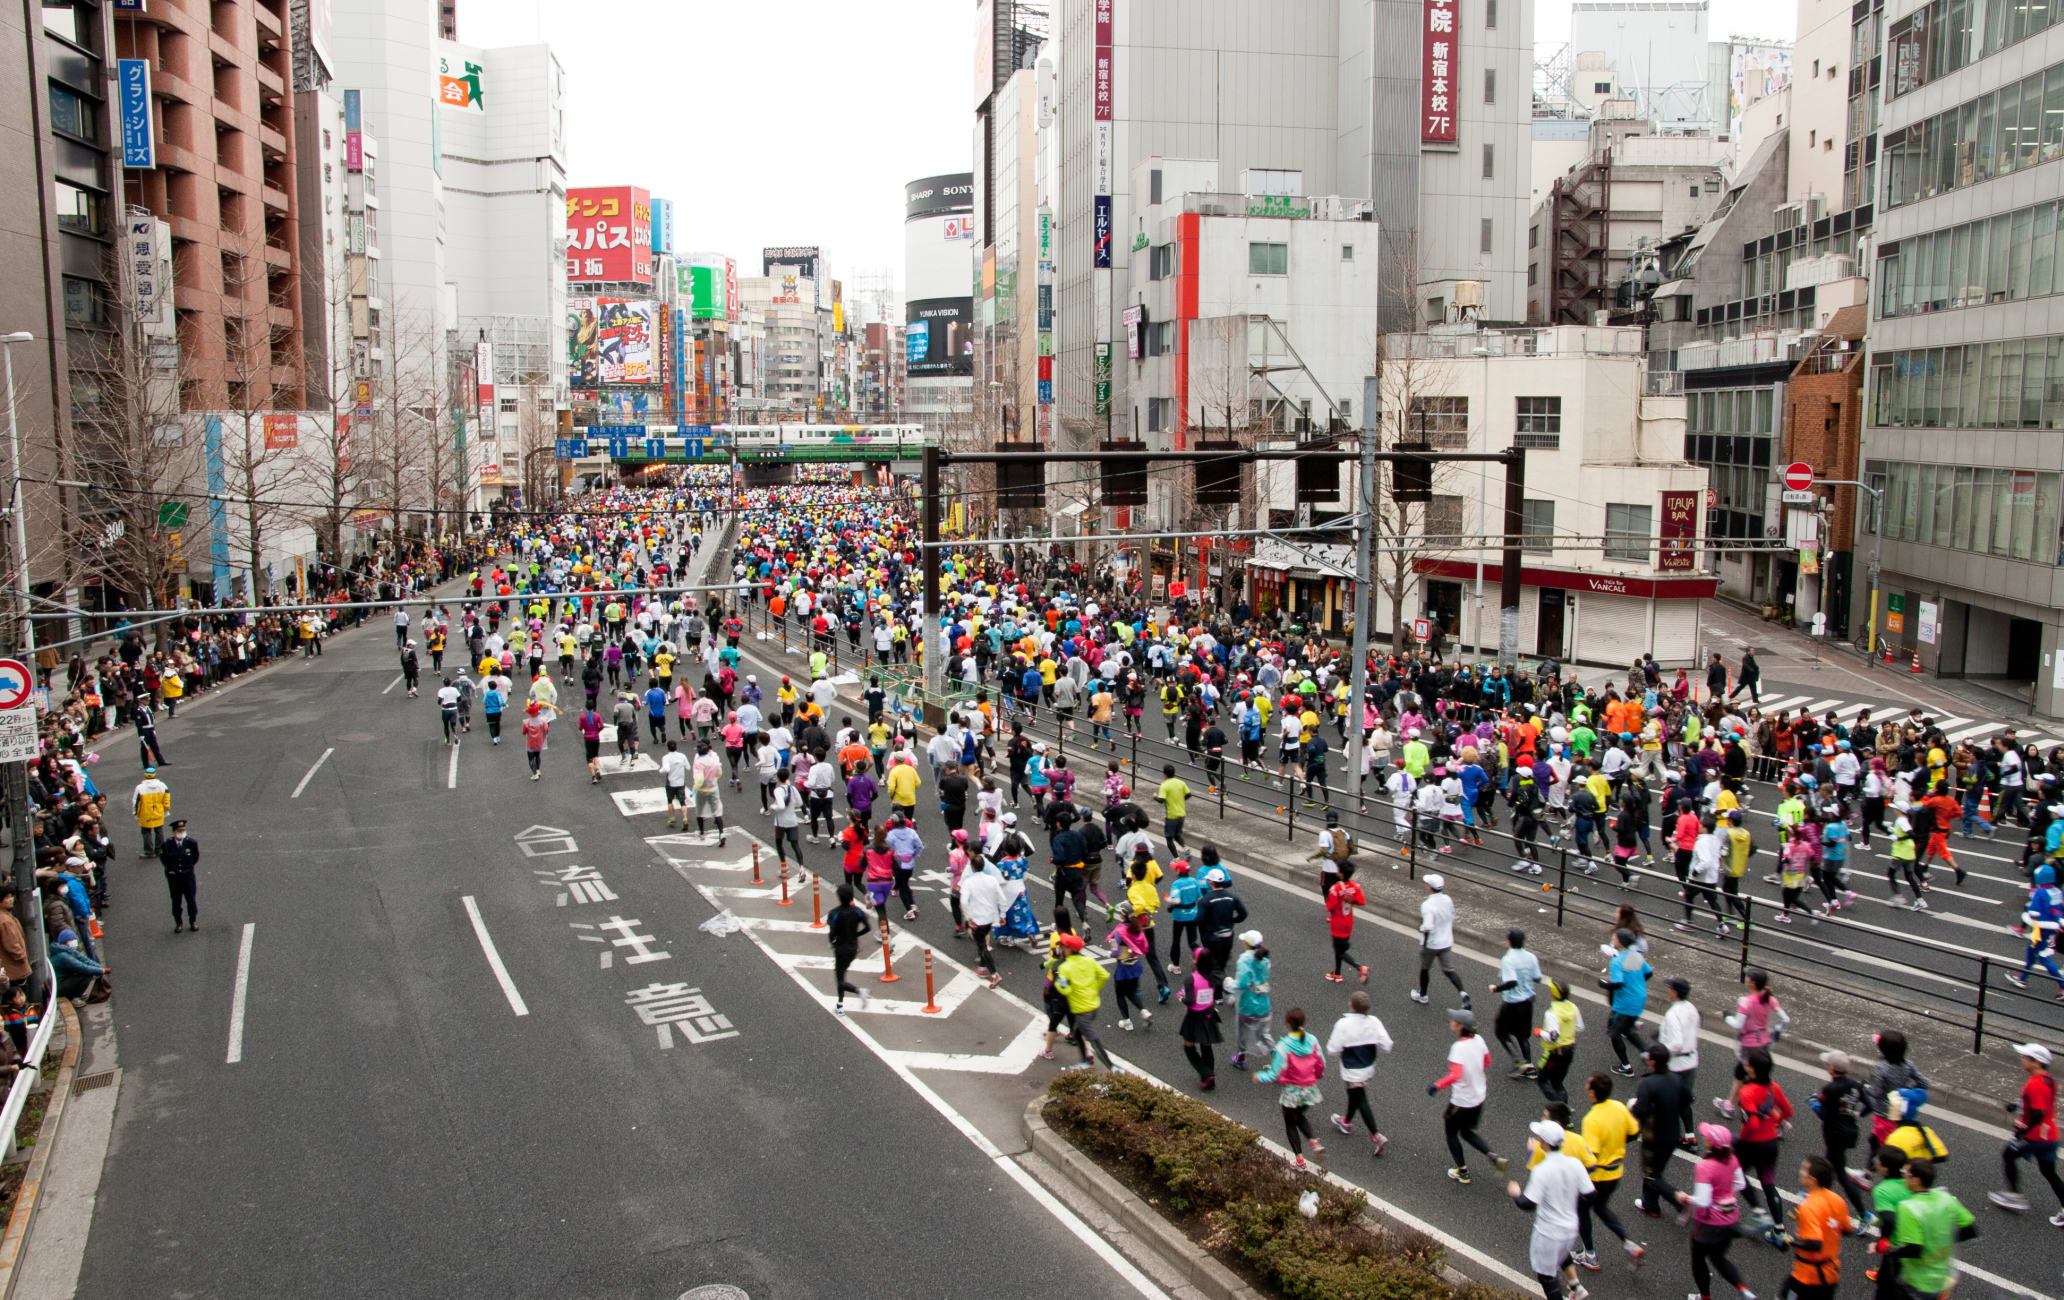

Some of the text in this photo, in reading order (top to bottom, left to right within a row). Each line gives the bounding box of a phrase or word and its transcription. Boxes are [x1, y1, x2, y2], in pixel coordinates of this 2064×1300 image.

[1098, 58, 1109, 102] 新宿本校
[1432, 41, 1449, 112] 新宿本校
[129, 65, 148, 162] グランシーズ
[1097, 105, 1110, 116] 7F
[1429, 116, 1450, 134] 7F
[911, 189, 934, 201] SHARP
[938, 308, 959, 317] VISION
[1667, 497, 1695, 510] ITALIA
[1672, 511, 1689, 521] BAR
